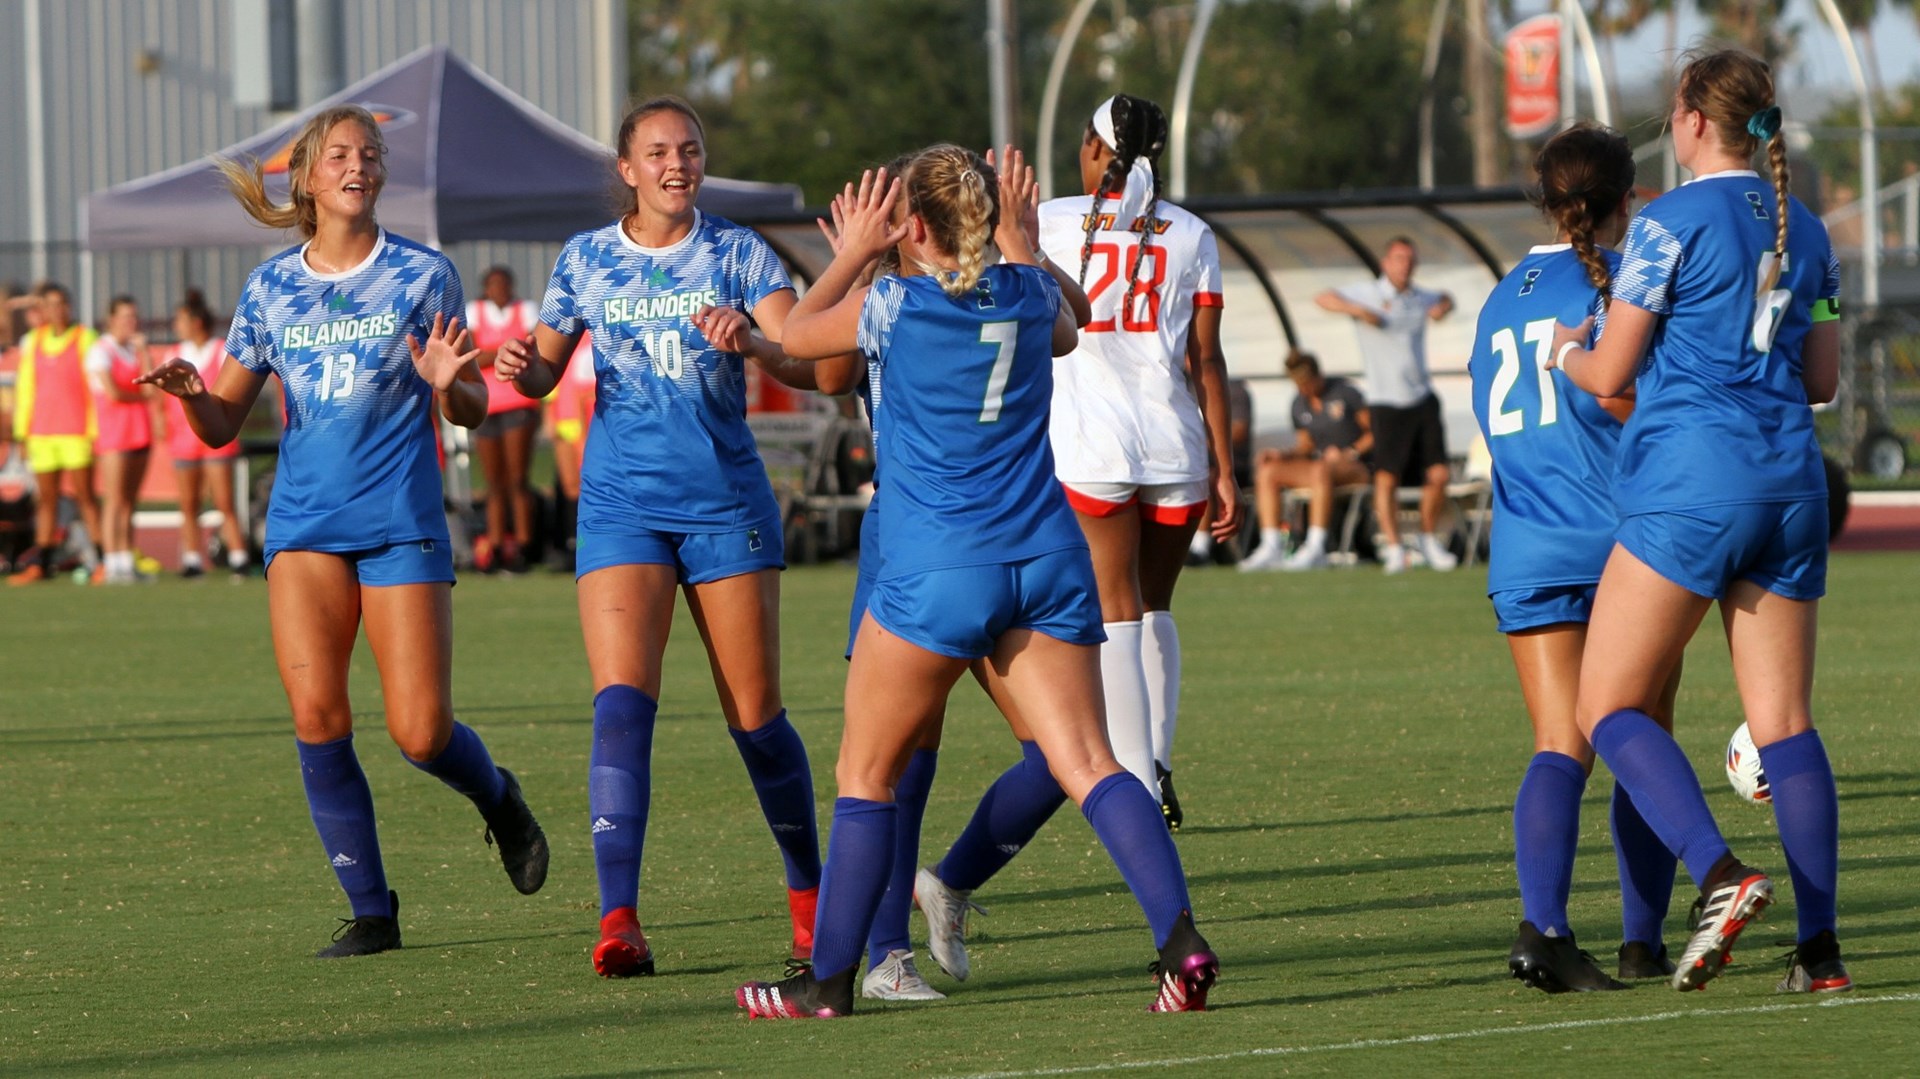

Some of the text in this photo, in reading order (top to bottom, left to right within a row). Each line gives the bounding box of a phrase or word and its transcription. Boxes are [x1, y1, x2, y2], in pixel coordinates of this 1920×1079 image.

[603, 290, 716, 325] ISLANDERS
[1080, 243, 1167, 333] 28
[1753, 251, 1792, 352] 6
[283, 313, 396, 349] ISLANDERS
[643, 330, 683, 380] 10
[320, 353, 356, 401] 13
[979, 321, 1018, 422] 7
[1488, 317, 1557, 437] 27
